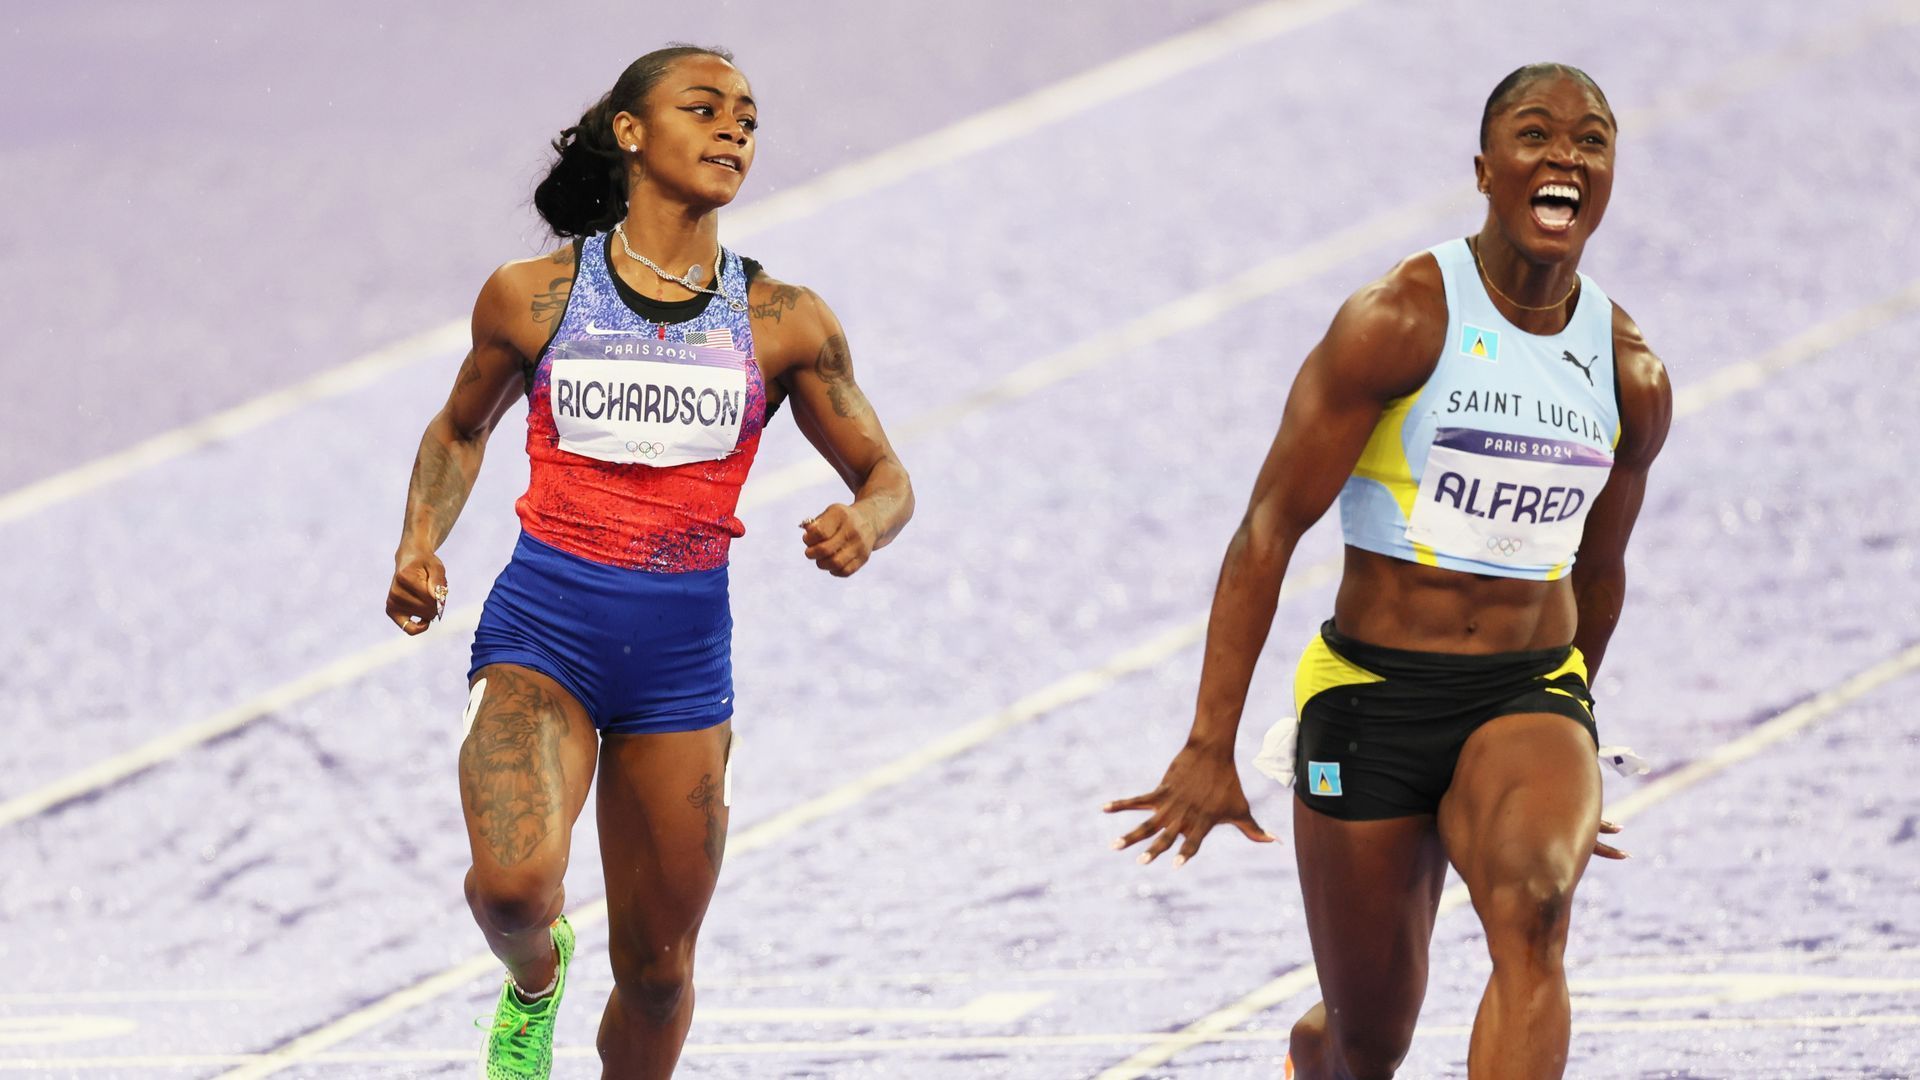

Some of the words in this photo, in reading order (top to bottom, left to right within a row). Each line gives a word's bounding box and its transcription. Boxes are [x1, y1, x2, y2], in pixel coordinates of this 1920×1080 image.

[605, 344, 650, 356] PARIS
[656, 345, 697, 360] 2024
[558, 379, 740, 426] RICHARDSON
[1447, 390, 1522, 416] SAINT
[1537, 400, 1603, 444] LUCIA
[1485, 437, 1527, 454] PARIS
[1532, 444, 1572, 458] 2024
[1434, 471, 1585, 525] ALFRED
